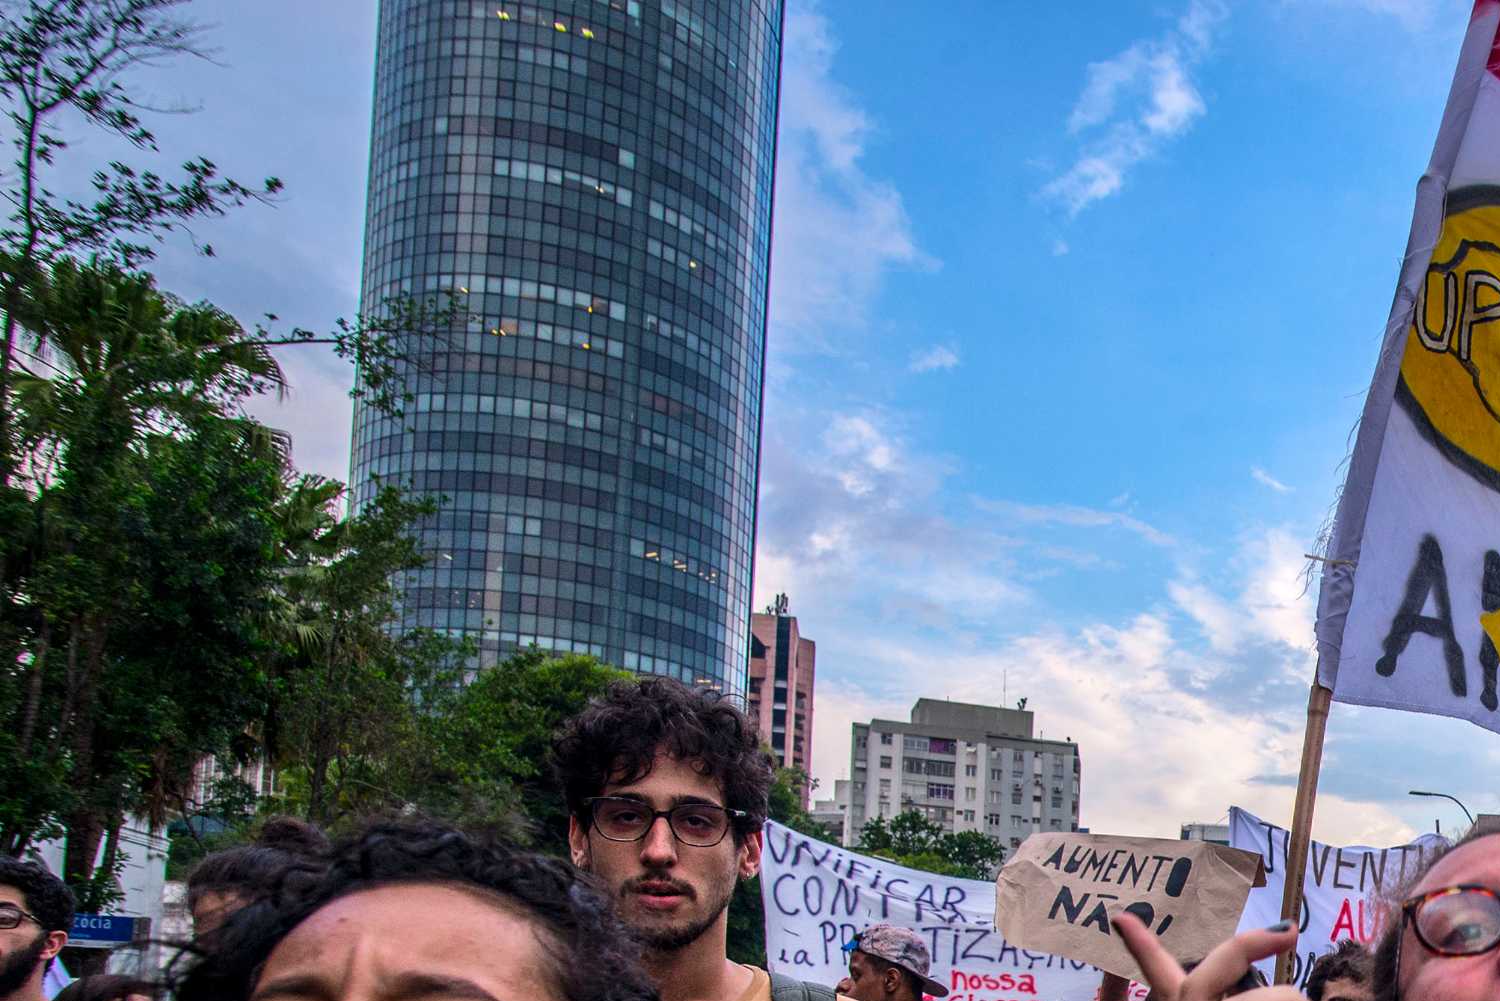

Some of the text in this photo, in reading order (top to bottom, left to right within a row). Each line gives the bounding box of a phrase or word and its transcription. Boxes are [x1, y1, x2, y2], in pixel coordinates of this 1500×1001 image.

[1043, 842, 1192, 898] AUMENTO
[73, 911, 112, 929] cócia
[951, 969, 1038, 994] nossa
